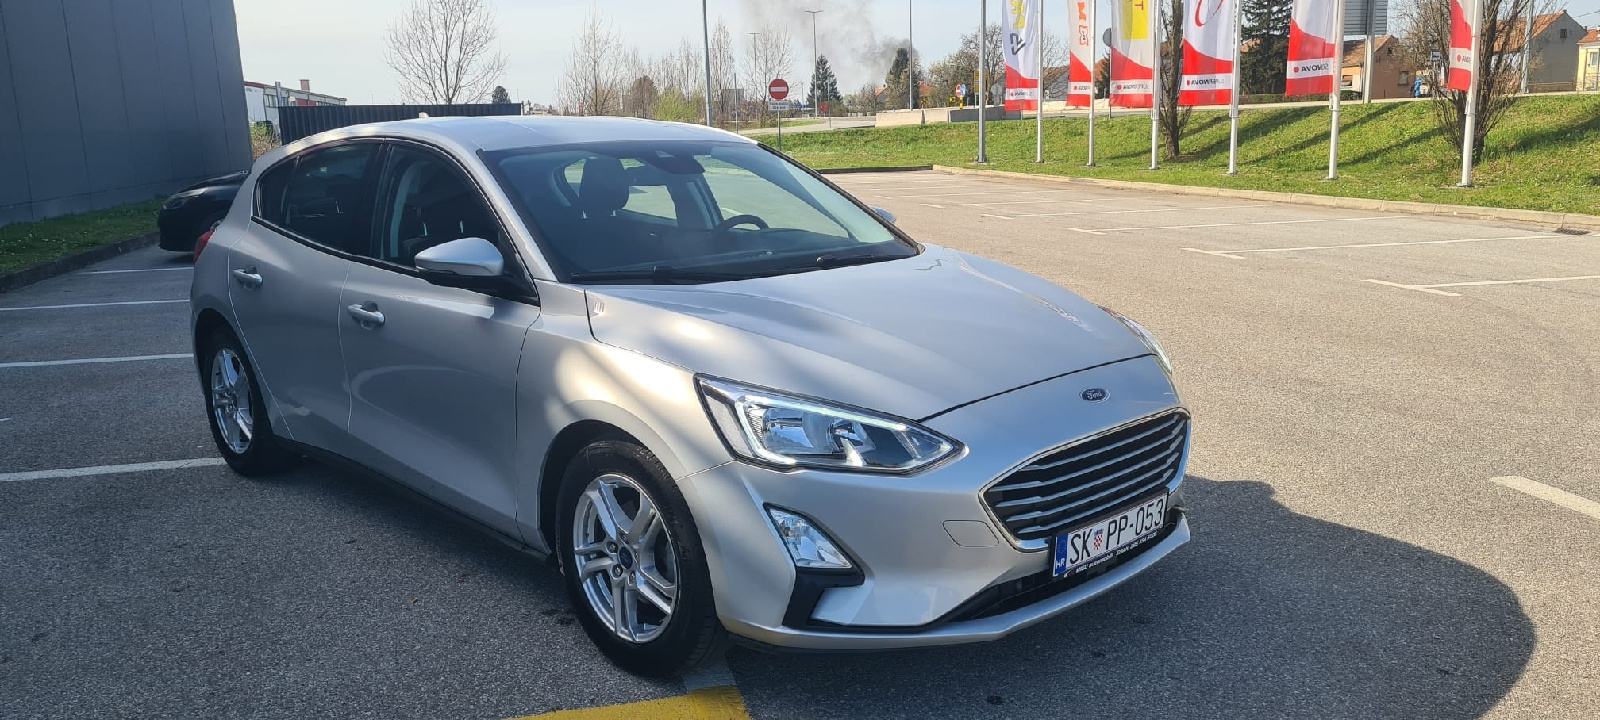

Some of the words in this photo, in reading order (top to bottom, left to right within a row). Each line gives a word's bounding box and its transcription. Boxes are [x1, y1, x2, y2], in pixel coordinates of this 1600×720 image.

[1069, 529, 1092, 565] SK
[1105, 498, 1164, 550] PP-053
[1055, 557, 1065, 568] HR
